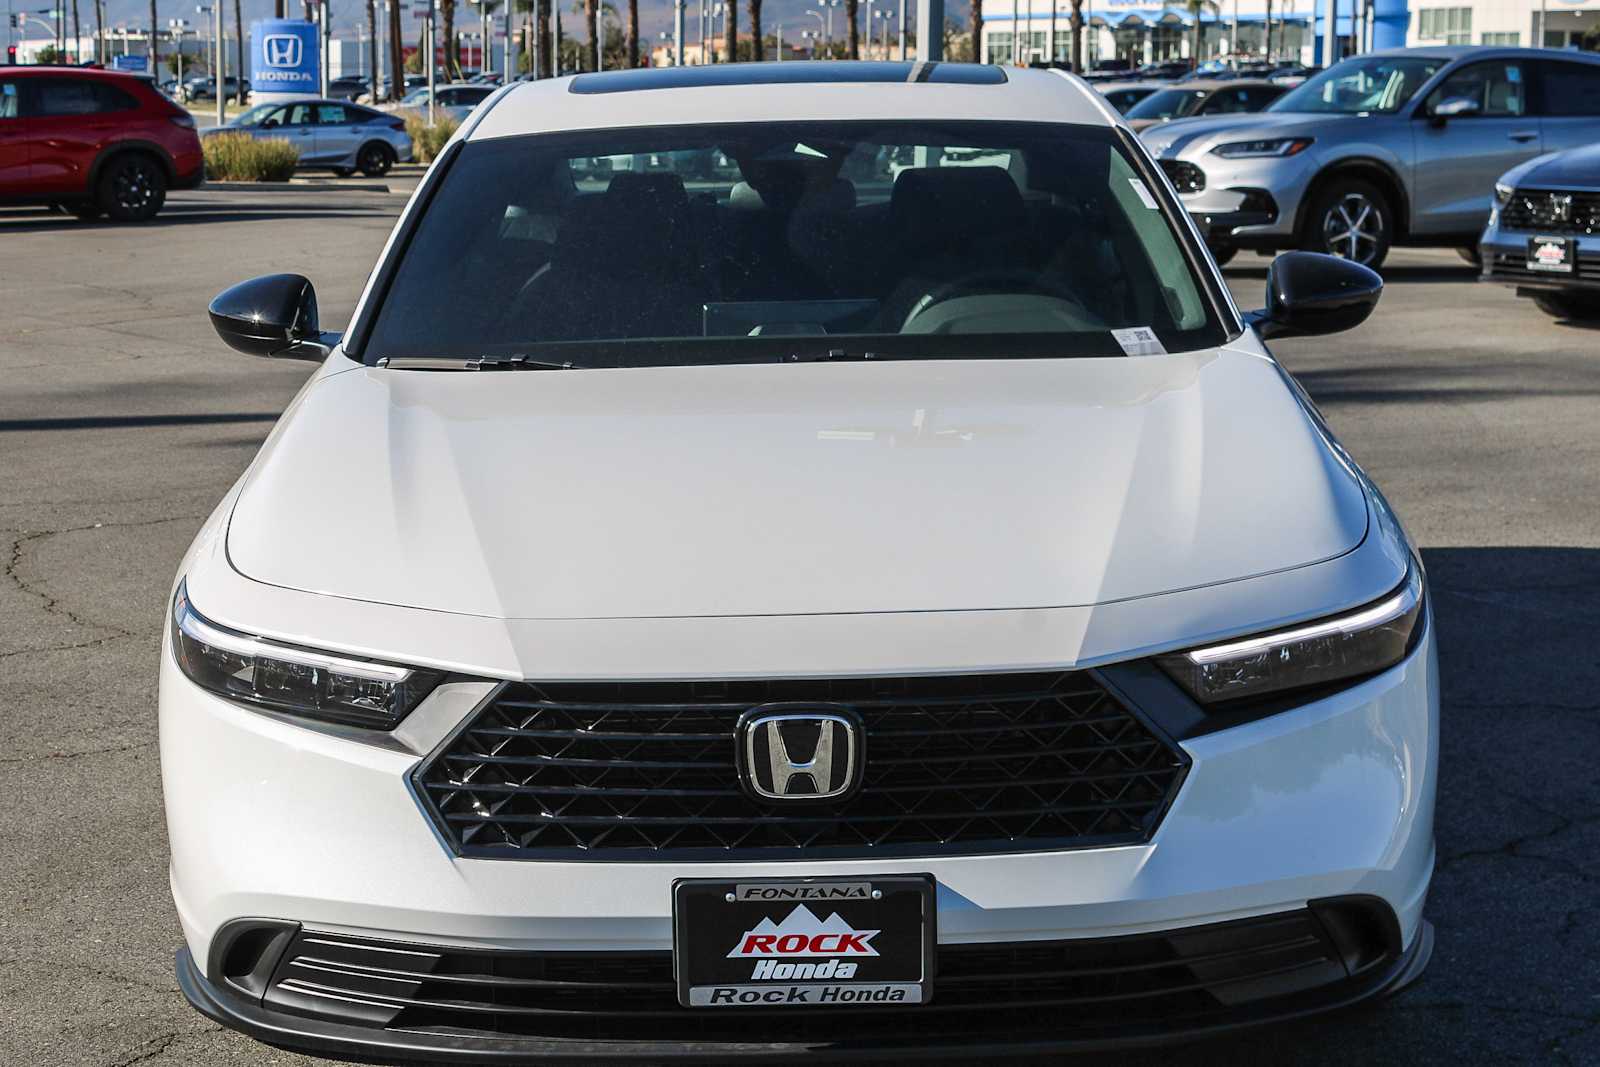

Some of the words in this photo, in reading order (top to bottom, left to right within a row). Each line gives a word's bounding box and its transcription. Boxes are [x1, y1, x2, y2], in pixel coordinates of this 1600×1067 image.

[254, 71, 313, 82] HONDA
[743, 887, 868, 899] FONTANA
[741, 933, 870, 954] ROCK
[750, 959, 859, 981] Honda
[709, 986, 811, 1004] Rock
[819, 985, 907, 1002] Honda
